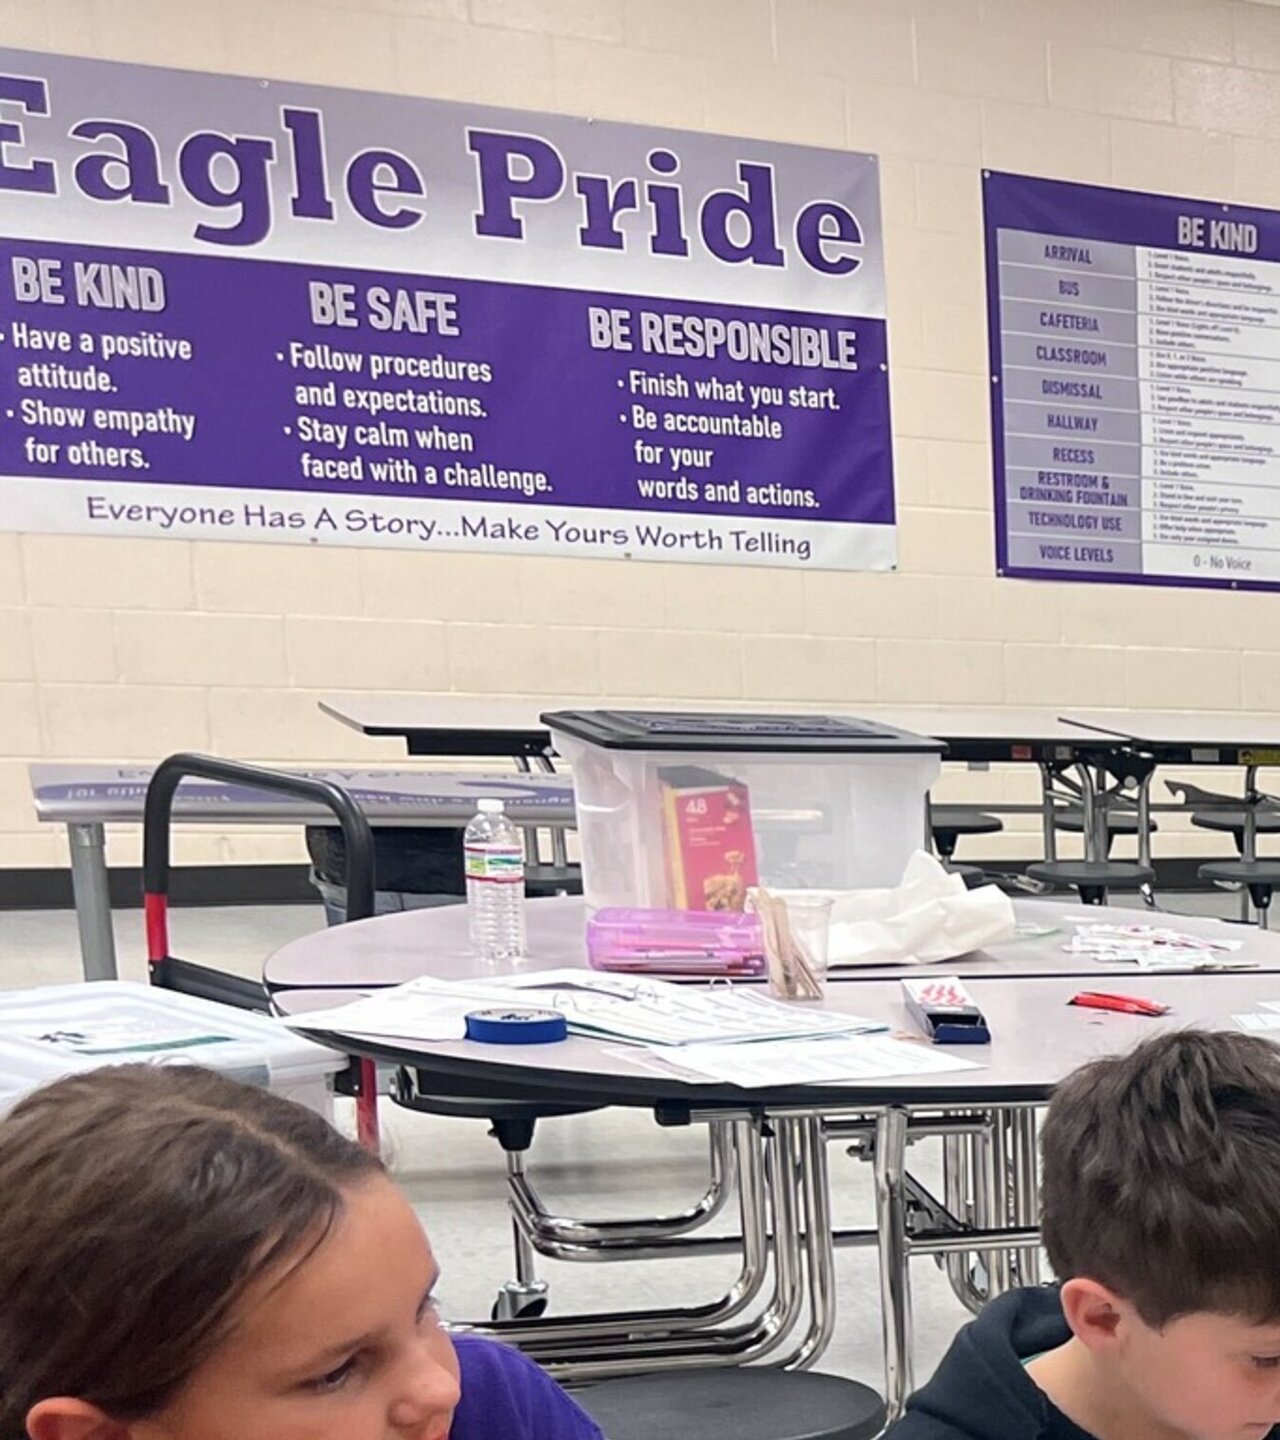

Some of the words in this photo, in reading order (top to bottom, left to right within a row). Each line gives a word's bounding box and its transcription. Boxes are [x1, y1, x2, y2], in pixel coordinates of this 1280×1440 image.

[0, 73, 426, 247] Eagle
[466, 126, 863, 276] Pride
[1177, 215, 1205, 246] BE
[1210, 220, 1258, 253] KIND
[1044, 245, 1092, 265] ARRIVAL
[12, 257, 65, 304] BE
[74, 262, 165, 312] KIND
[1058, 280, 1080, 296] BUS
[309, 281, 358, 327] BE
[367, 286, 459, 335] SAFE
[1039, 312, 1100, 333] CAFETERIA
[12, 323, 70, 352] Have
[79, 333, 94, 354] a
[102, 332, 192, 362] positive
[588, 306, 633, 351] BE
[641, 311, 858, 370] RESPONSIBLE
[290, 343, 363, 373] Follow
[369, 351, 492, 382] procedures
[1036, 346, 1107, 367] CLASSROOM
[18, 364, 117, 393] attitude.
[629, 370, 688, 398] Finish
[695, 379, 744, 403] what
[751, 385, 782, 408] you
[789, 387, 840, 410] start.
[1042, 380, 1103, 400] DISMISSAL
[295, 383, 336, 408] and
[343, 387, 488, 418] expectations.
[20, 400, 85, 428] Show
[93, 407, 195, 440] empathy
[297, 418, 347, 449] Stay
[354, 423, 409, 448] calm
[415, 427, 473, 453] when
[632, 405, 657, 430] Be
[663, 411, 782, 439] accountable
[1047, 414, 1098, 432] HALLWAY
[25, 437, 60, 464] for
[67, 441, 150, 469] others.
[635, 440, 663, 464] for
[670, 446, 713, 471] your
[1052, 447, 1095, 465] RECESS
[301, 453, 364, 481] faced
[369, 457, 418, 484] with
[424, 467, 437, 485] a
[444, 460, 552, 496] challenge.
[1038, 471, 1099, 489] RESTROOM
[1101, 476, 1110, 489] &
[637, 478, 698, 502] words
[704, 481, 740, 504] and
[746, 484, 820, 508] actions.
[1020, 487, 1073, 503] DRINKING
[1076, 490, 1129, 508] FOUNTAIN
[86, 496, 235, 528] Everyone
[244, 505, 305, 529] Has
[314, 508, 337, 531] A
[545, 518, 629, 546] Yours
[635, 524, 722, 551] Worth
[729, 530, 811, 560] Telling
[1028, 511, 1099, 531] TECHNOLOGY
[1101, 516, 1123, 532] USE
[1039, 545, 1071, 561] VOICE
[1074, 547, 1114, 564] LEVELS
[1210, 555, 1224, 569] No
[1227, 557, 1252, 571] Voice
